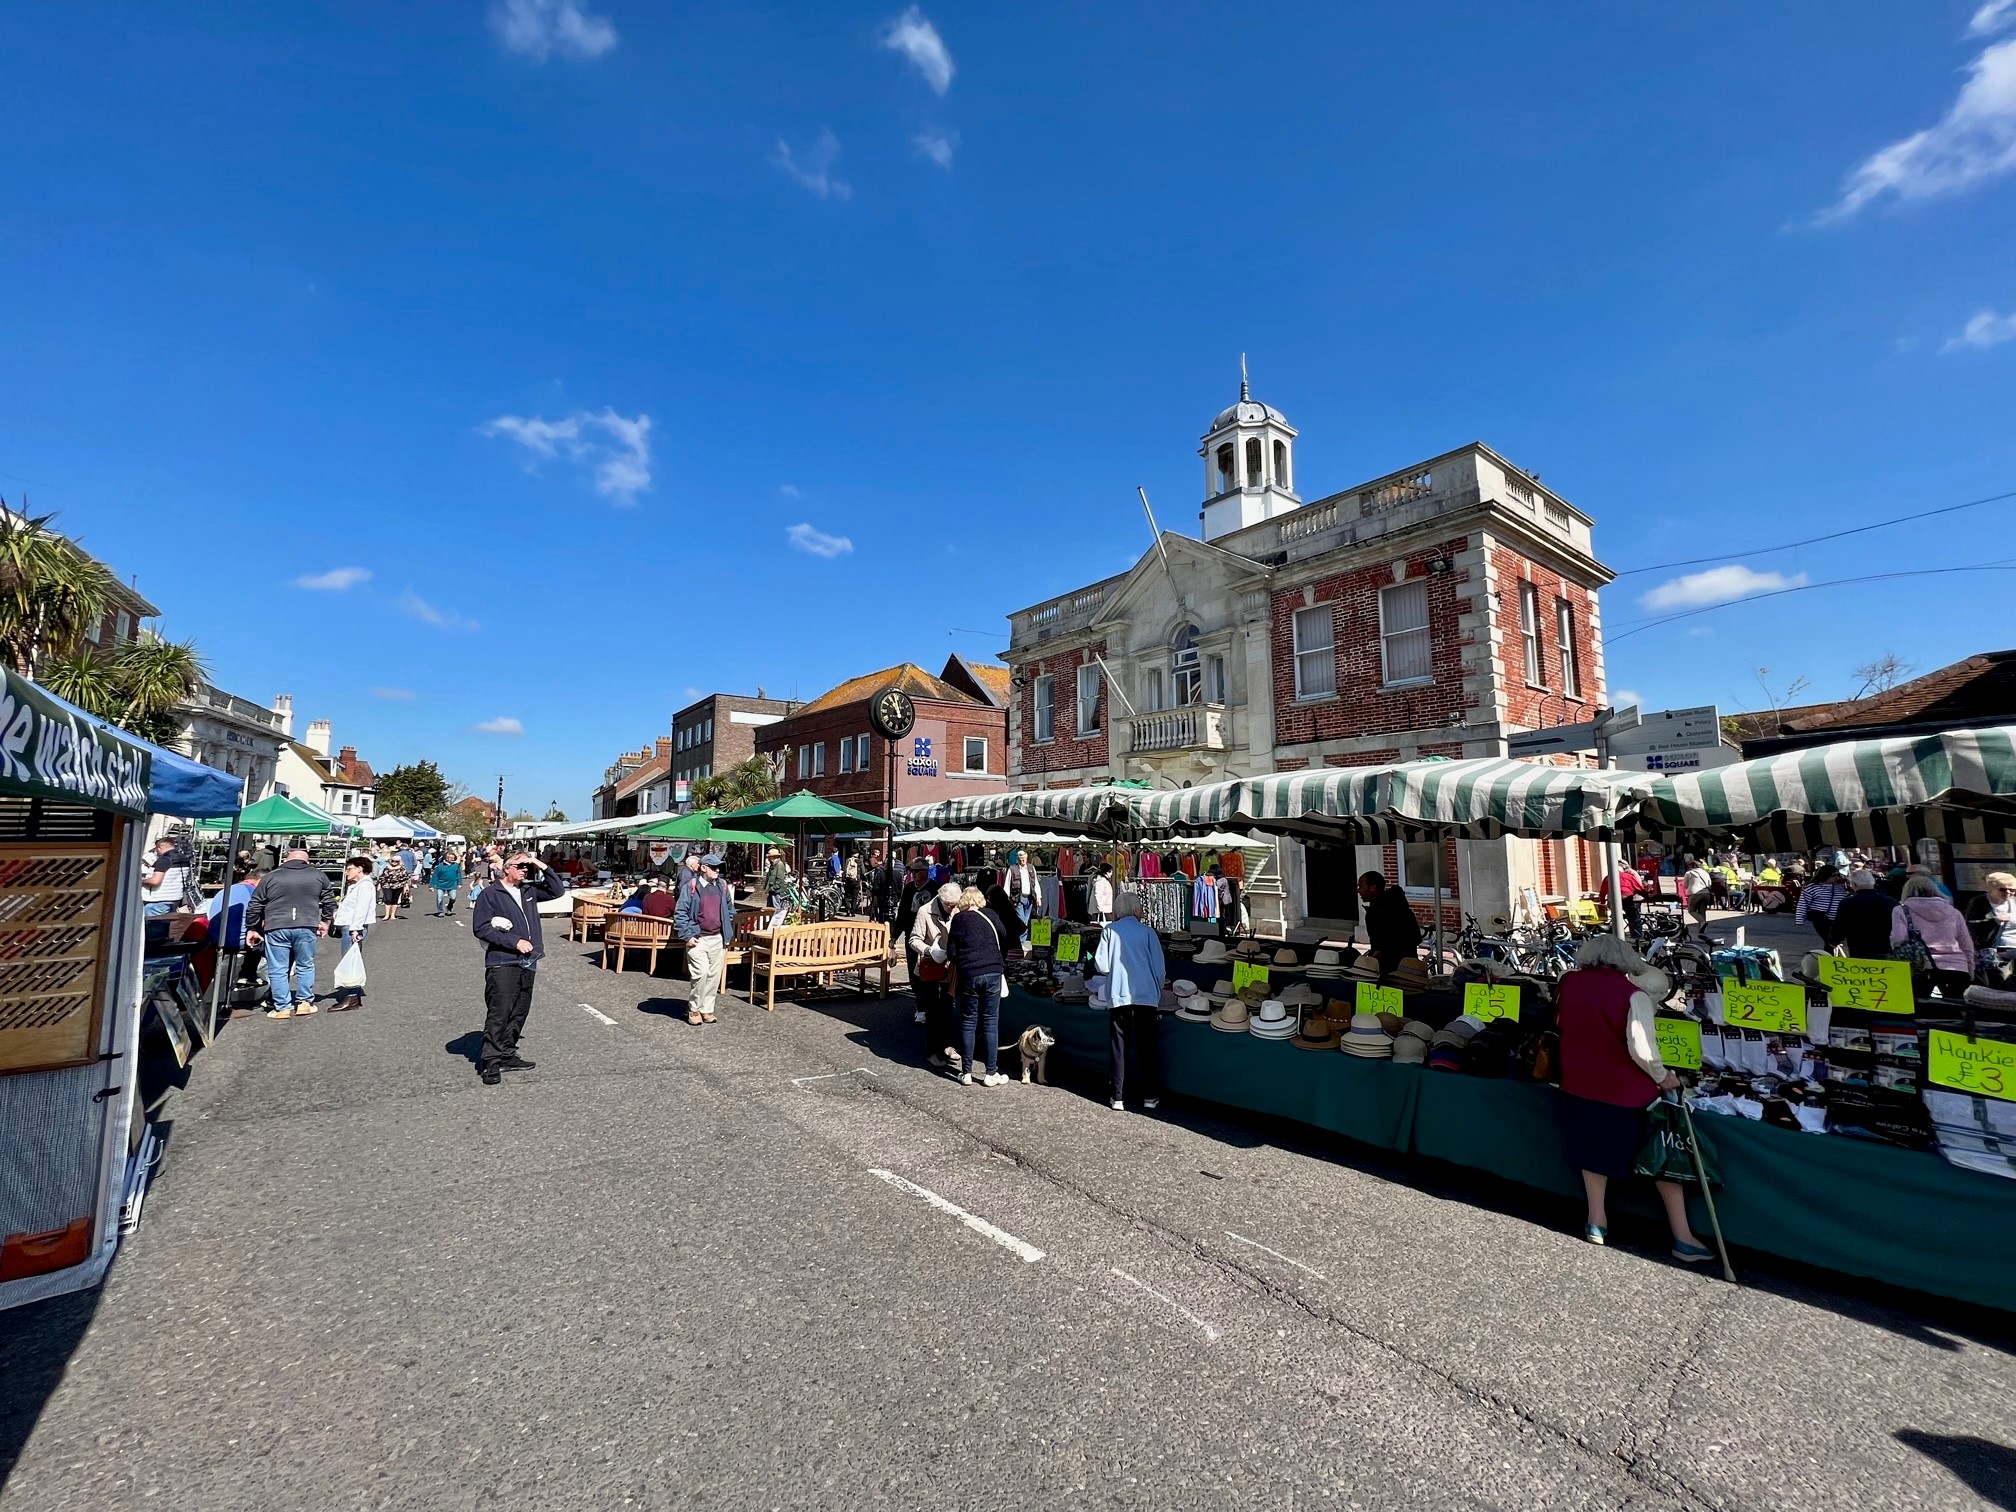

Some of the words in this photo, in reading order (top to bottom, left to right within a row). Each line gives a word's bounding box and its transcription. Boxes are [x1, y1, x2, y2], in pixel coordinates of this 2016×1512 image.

[907, 757, 938, 768] saxon
[1664, 760, 1700, 769] SQUARE
[106, 741, 148, 813] stall
[907, 767, 938, 777] SQUARE
[1832, 960, 1894, 976] Boxer
[1729, 979, 1781, 993] Tainer
[1831, 975, 1888, 991] Shorts
[1360, 984, 1399, 1006] Hats
[1469, 984, 1506, 999] Caps
[1845, 987, 1889, 1009] £7
[1470, 997, 1506, 1019] £5
[1729, 1003, 1762, 1022] £2
[1946, 1061, 2004, 1093] £3
